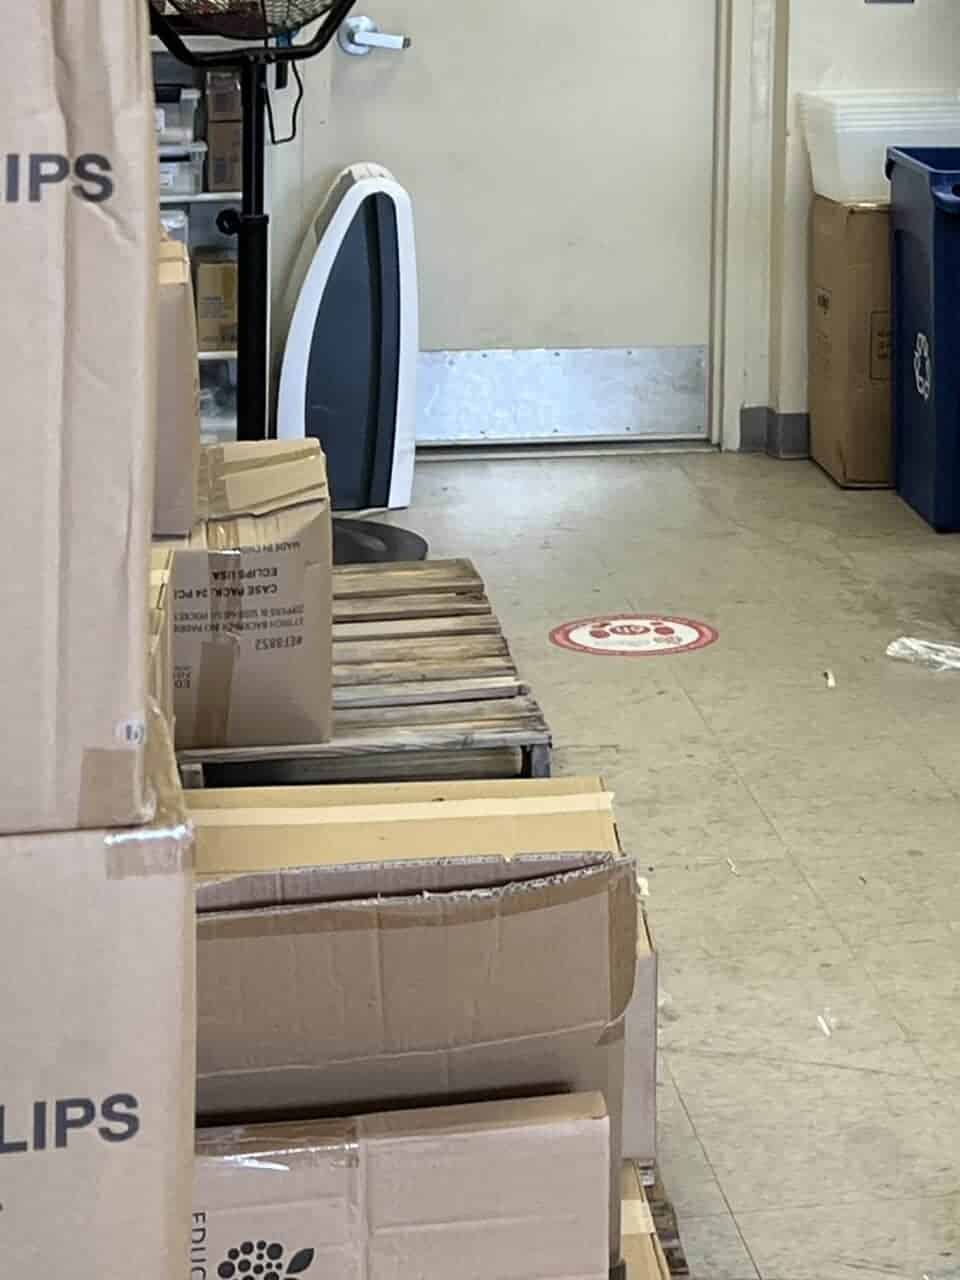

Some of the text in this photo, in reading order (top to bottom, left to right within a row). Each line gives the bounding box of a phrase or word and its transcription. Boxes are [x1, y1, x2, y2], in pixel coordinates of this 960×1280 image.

[5, 153, 113, 202] IPS
[246, 583, 278, 597] CASE
[0, 1092, 140, 1154] LIPS
